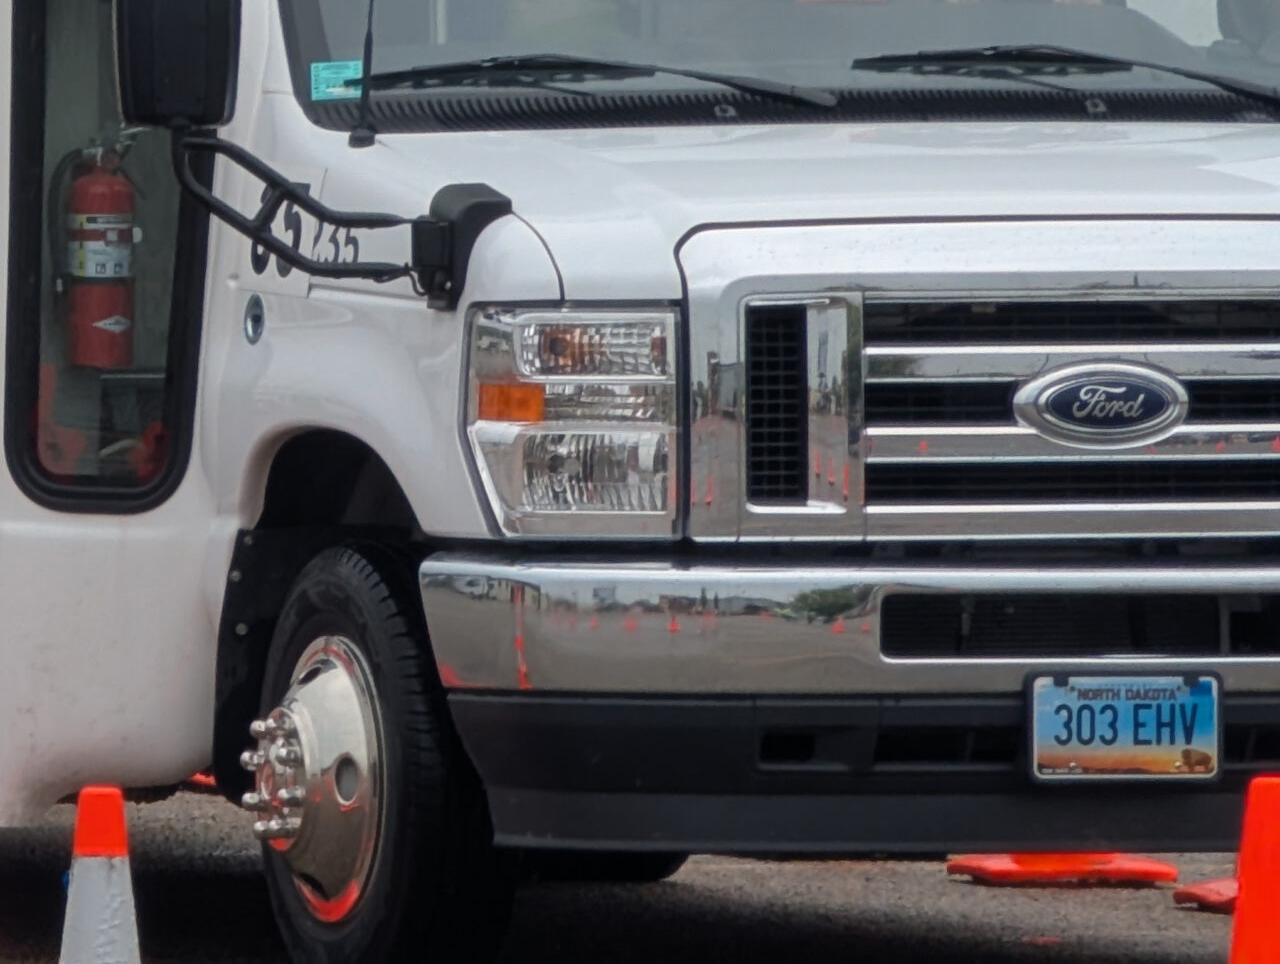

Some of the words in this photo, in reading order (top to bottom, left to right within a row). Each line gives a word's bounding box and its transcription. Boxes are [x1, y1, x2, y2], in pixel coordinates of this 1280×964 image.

[1072, 386, 1145, 419] Ford
[1077, 687, 1120, 700] NORTH
[1125, 687, 1177, 701] DAKOTA
[1054, 704, 1119, 746] 303
[1133, 703, 1198, 746] EHV
